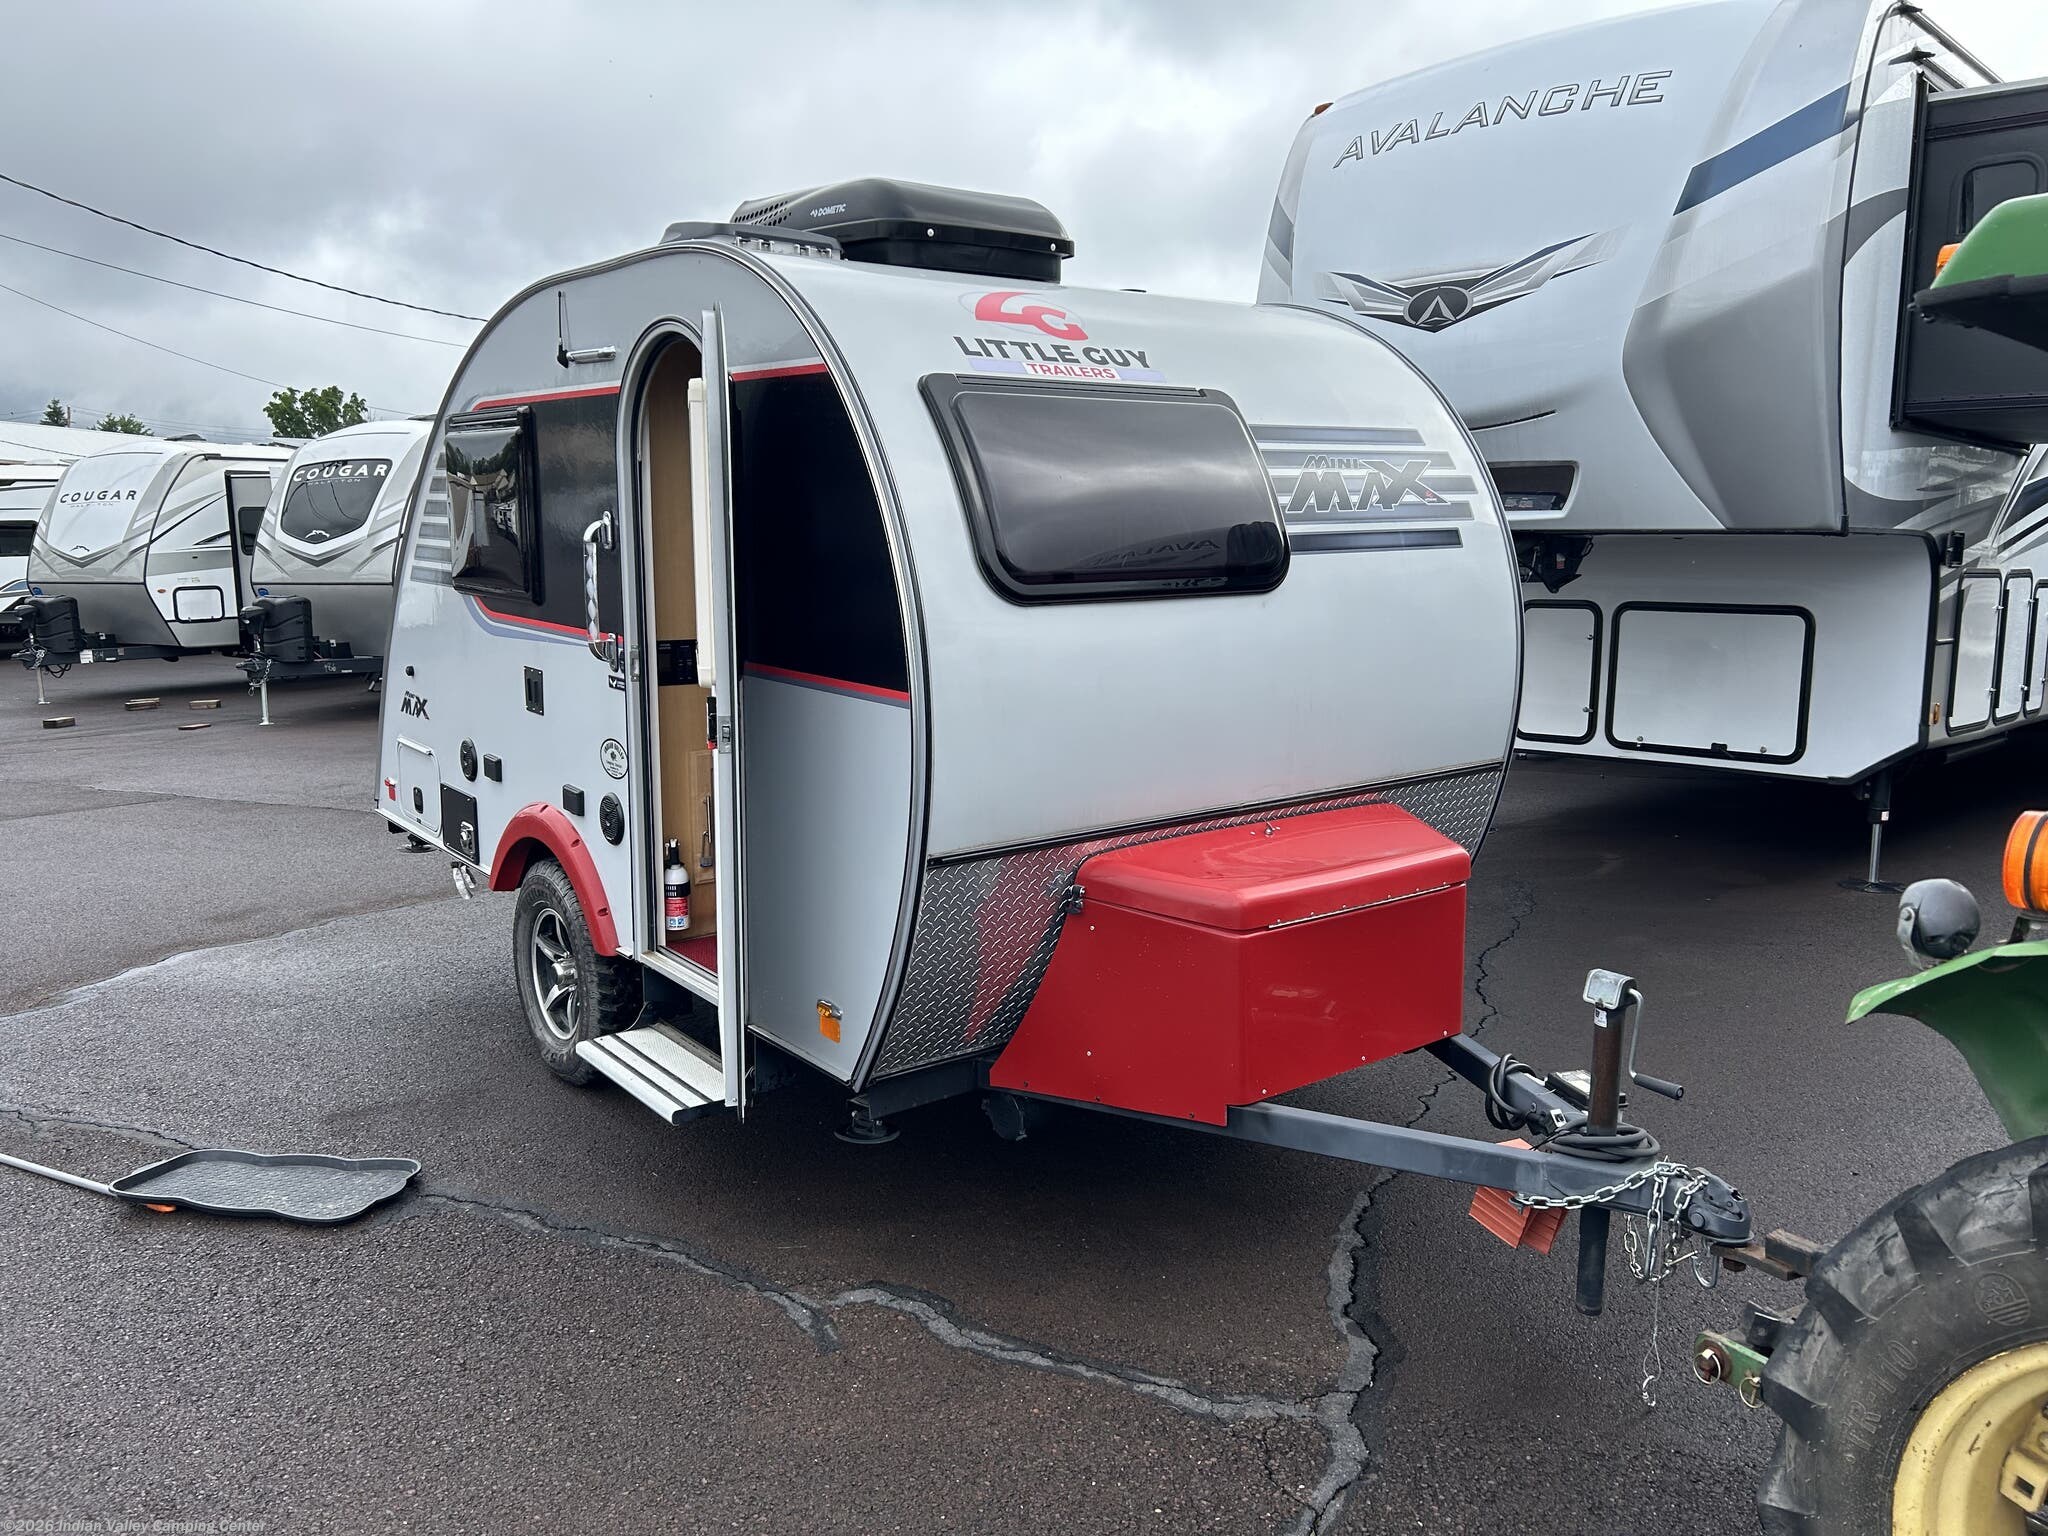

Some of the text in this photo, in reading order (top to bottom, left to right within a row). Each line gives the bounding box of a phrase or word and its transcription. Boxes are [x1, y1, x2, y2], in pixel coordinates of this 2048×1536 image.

[1333, 70, 1672, 168] AVALANCHE
[818, 203, 846, 217] DOMETIC
[953, 336, 1151, 369] LITTLE GUY
[1026, 363, 1117, 379] TRAILERS
[1302, 455, 1360, 469] MINI
[293, 464, 388, 482] COUGAR
[1285, 459, 1451, 513] MAX
[60, 490, 137, 503] COUGAR
